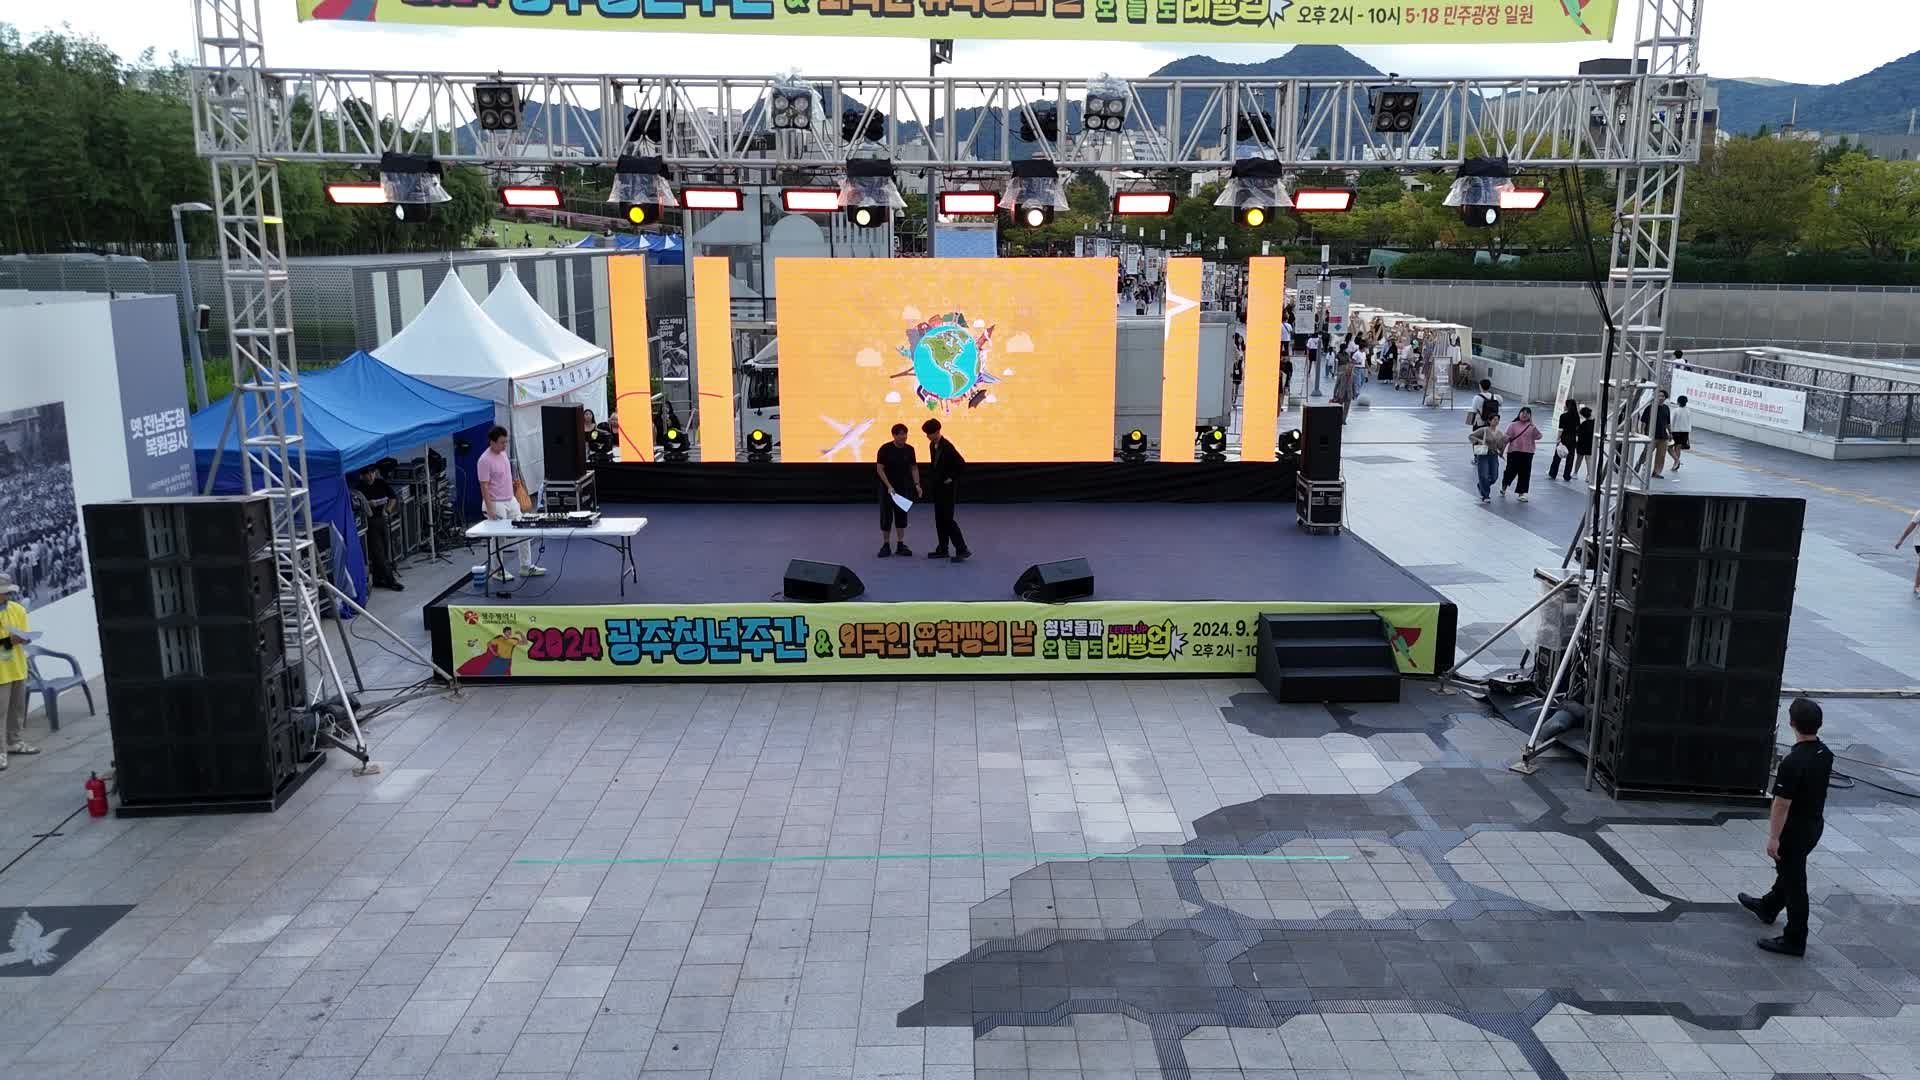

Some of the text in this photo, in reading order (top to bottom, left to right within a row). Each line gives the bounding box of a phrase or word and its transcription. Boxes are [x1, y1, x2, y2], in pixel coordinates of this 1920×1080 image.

[1297, 6, 1326, 25] 오후
[1329, 6, 1353, 26] 2시
[1368, 6, 1400, 26] 10시
[1405, 6, 1439, 24] 5·18
[1443, 5, 1500, 26] 민주광장
[1504, 4, 1534, 25] 일원
[143, 408, 186, 436] 전남도청
[146, 428, 188, 456] 복원공사
[1043, 618, 1105, 640] 청년돌파
[1107, 618, 1173, 659] 레벨업
[1134, 623, 1149, 635] UP
[1192, 621, 1233, 637] 2024.
[1235, 619, 1250, 637] 9.
[527, 616, 1037, 665] 2024 광주청년주간 & 외국인 유학생의 날
[1191, 643, 1214, 658] 오후
[1216, 643, 1234, 658] 2시
